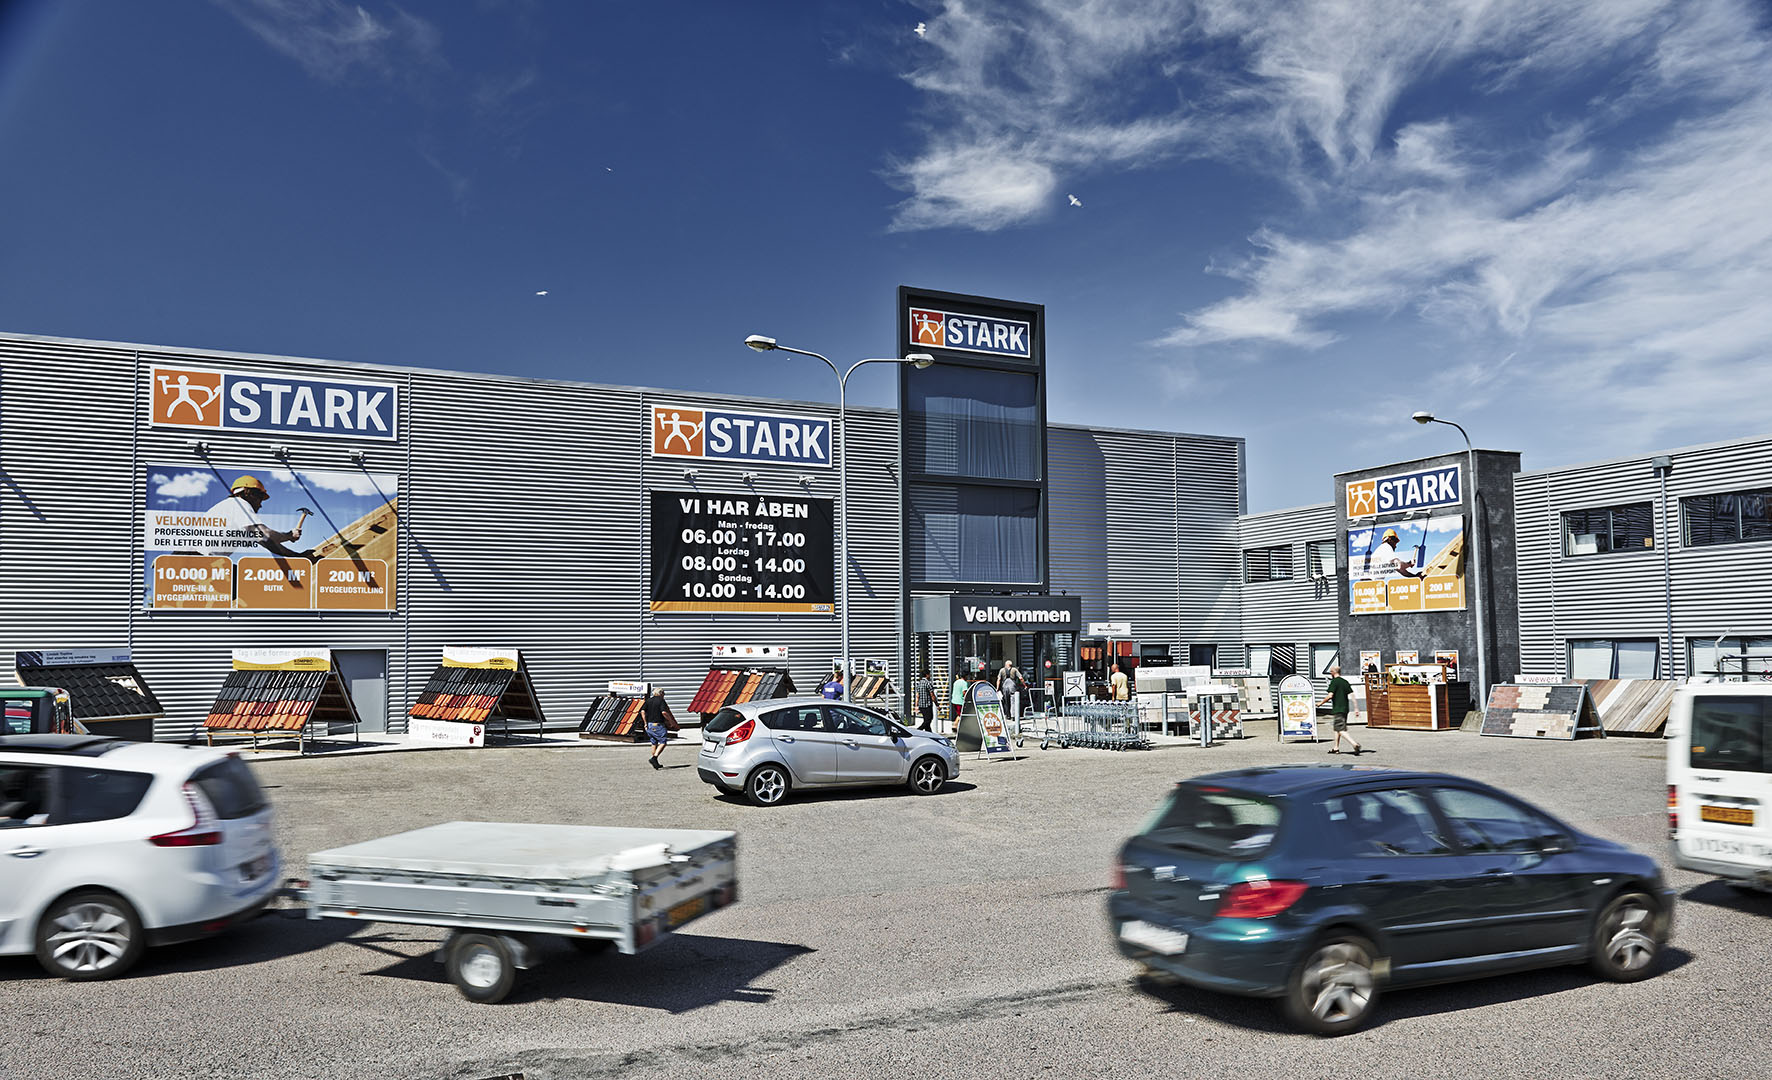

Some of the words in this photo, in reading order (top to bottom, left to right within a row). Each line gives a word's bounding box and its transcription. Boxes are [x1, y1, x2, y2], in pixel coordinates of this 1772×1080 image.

[948, 319, 1025, 352] STARK
[229, 380, 388, 432] STARK
[709, 417, 826, 459] STARK
[1379, 471, 1457, 509] STARK
[680, 499, 700, 514] VI
[707, 500, 749, 516] HAR
[755, 497, 809, 519] ÅBEN
[155, 515, 227, 528] VELKOMMEN
[718, 521, 738, 530] Man
[745, 522, 775, 532] fredag
[154, 528, 224, 538] PROFESSIONELLE
[226, 529, 264, 539] SERVICES
[682, 529, 737, 544] 06.00
[755, 532, 806, 548] 17.00
[154, 539, 171, 548] DER
[173, 540, 201, 548] LETTER
[221, 541, 259, 549] HVERDAG
[718, 548, 750, 558] Lørdag
[682, 556, 737, 571] 08.00
[755, 558, 806, 574] 14.00
[157, 567, 207, 581] 10.000
[244, 569, 284, 581] 2.000
[329, 570, 355, 583] 200
[718, 574, 752, 584] Søndag
[172, 584, 207, 593] DRIVE-IN
[208, 585, 215, 593] &
[263, 585, 284, 593] BUTIK
[319, 585, 384, 595] BYGGEUDSTILLING
[682, 583, 737, 598] 10.00
[755, 584, 806, 599] 14.00
[1390, 585, 1409, 594] 2.000
[1429, 583, 1442, 592] 200
[157, 593, 230, 603] BYGGEMATERIALER
[963, 606, 1071, 623] Velkommen
